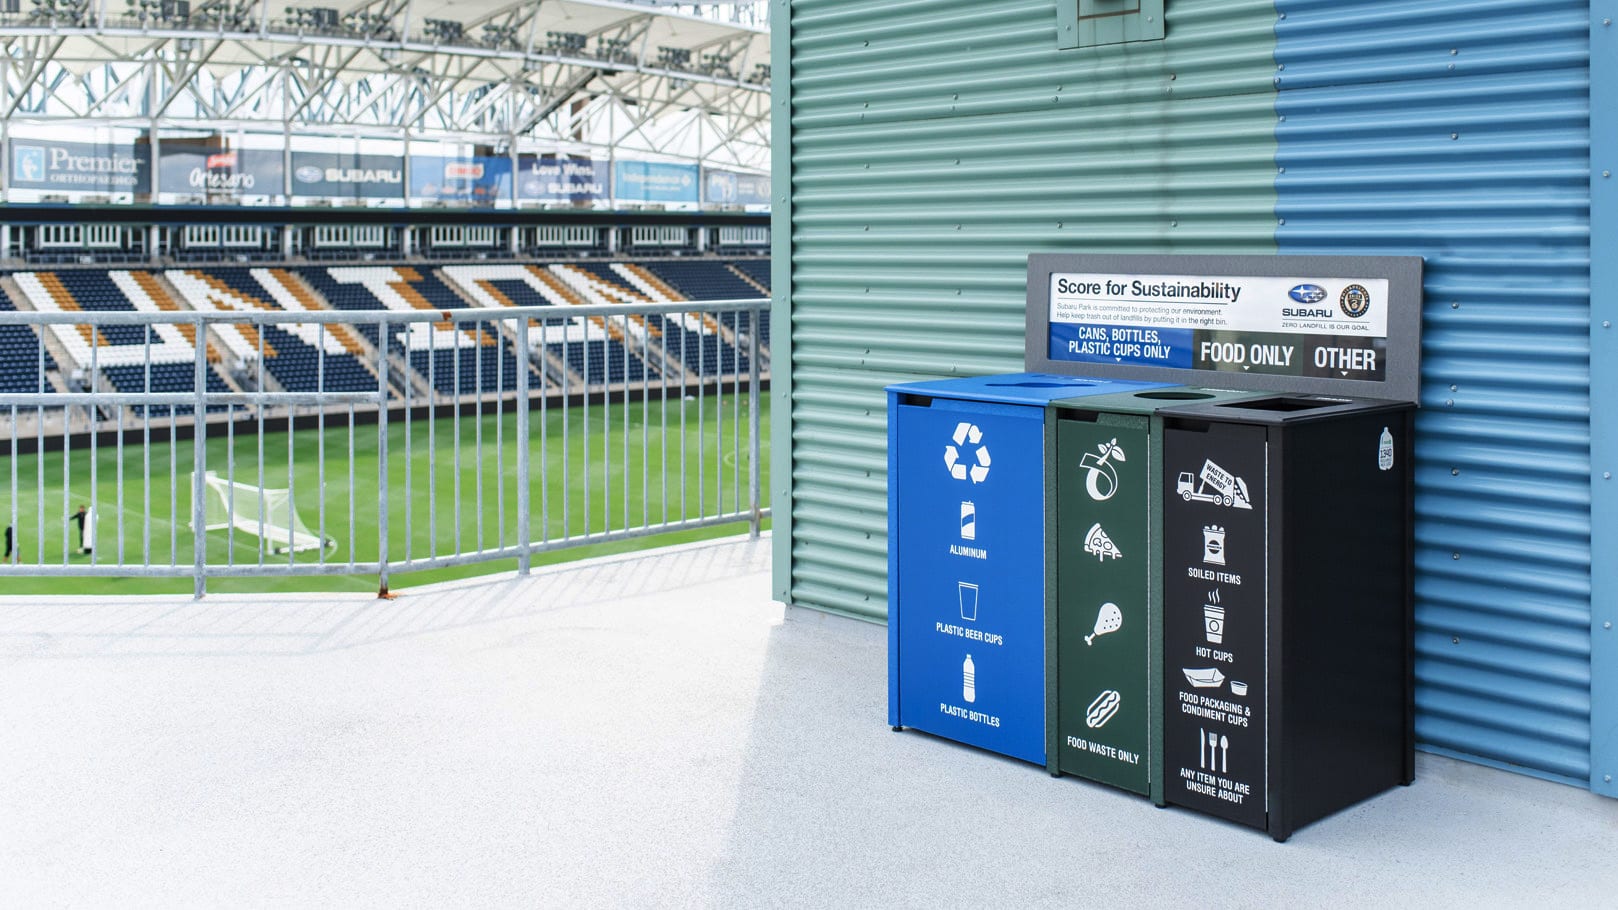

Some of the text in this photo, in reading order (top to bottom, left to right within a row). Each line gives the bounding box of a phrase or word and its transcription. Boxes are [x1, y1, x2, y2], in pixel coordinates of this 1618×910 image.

[49, 147, 138, 173] Premier
[325, 168, 401, 183] SUBARU
[548, 182, 602, 194] SUBARU
[1058, 278, 1241, 302] Score for Sustainability
[1057, 302, 1077, 310] Subaru
[1099, 304, 1130, 312] committed
[1139, 306, 1170, 315] protecting
[1057, 311, 1070, 319] Help
[1071, 312, 1085, 320] keep
[1087, 312, 1101, 320] trash
[1120, 314, 1143, 322] landfills
[1144, 314, 1151, 323] by
[1153, 315, 1174, 324] putting
[1189, 316, 1199, 324] the
[1200, 317, 1214, 326] right
[1282, 308, 1333, 318] SUBARU
[1078, 326, 1161, 345] CANS, BOTTLES,
[1069, 340, 1171, 359] PLASTIC CUPS ONLY
[1200, 342, 1294, 367] FOOD ONLY
[1314, 346, 1376, 371] OTHER
[1205, 473, 1226, 490] ENERGY
[1206, 464, 1233, 486] WASTE TO
[949, 544, 987, 560] ALUMINUM
[1188, 567, 1241, 585] SOILED ITEMS
[936, 622, 1003, 646] PLASTIC BEER CUPS
[1195, 646, 1233, 663] HOT CUPS
[940, 702, 1000, 727] PLASTIC BOTTLES
[1179, 691, 1251, 717] FOOD PACKAGING &
[1182, 703, 1248, 727] CONDIMENT CUPS
[1067, 735, 1139, 765] FOOD WASTE ONLY
[1180, 767, 1250, 795] ANY ITEM YOU ARE
[1186, 780, 1243, 804] UNSURE ABOUT
